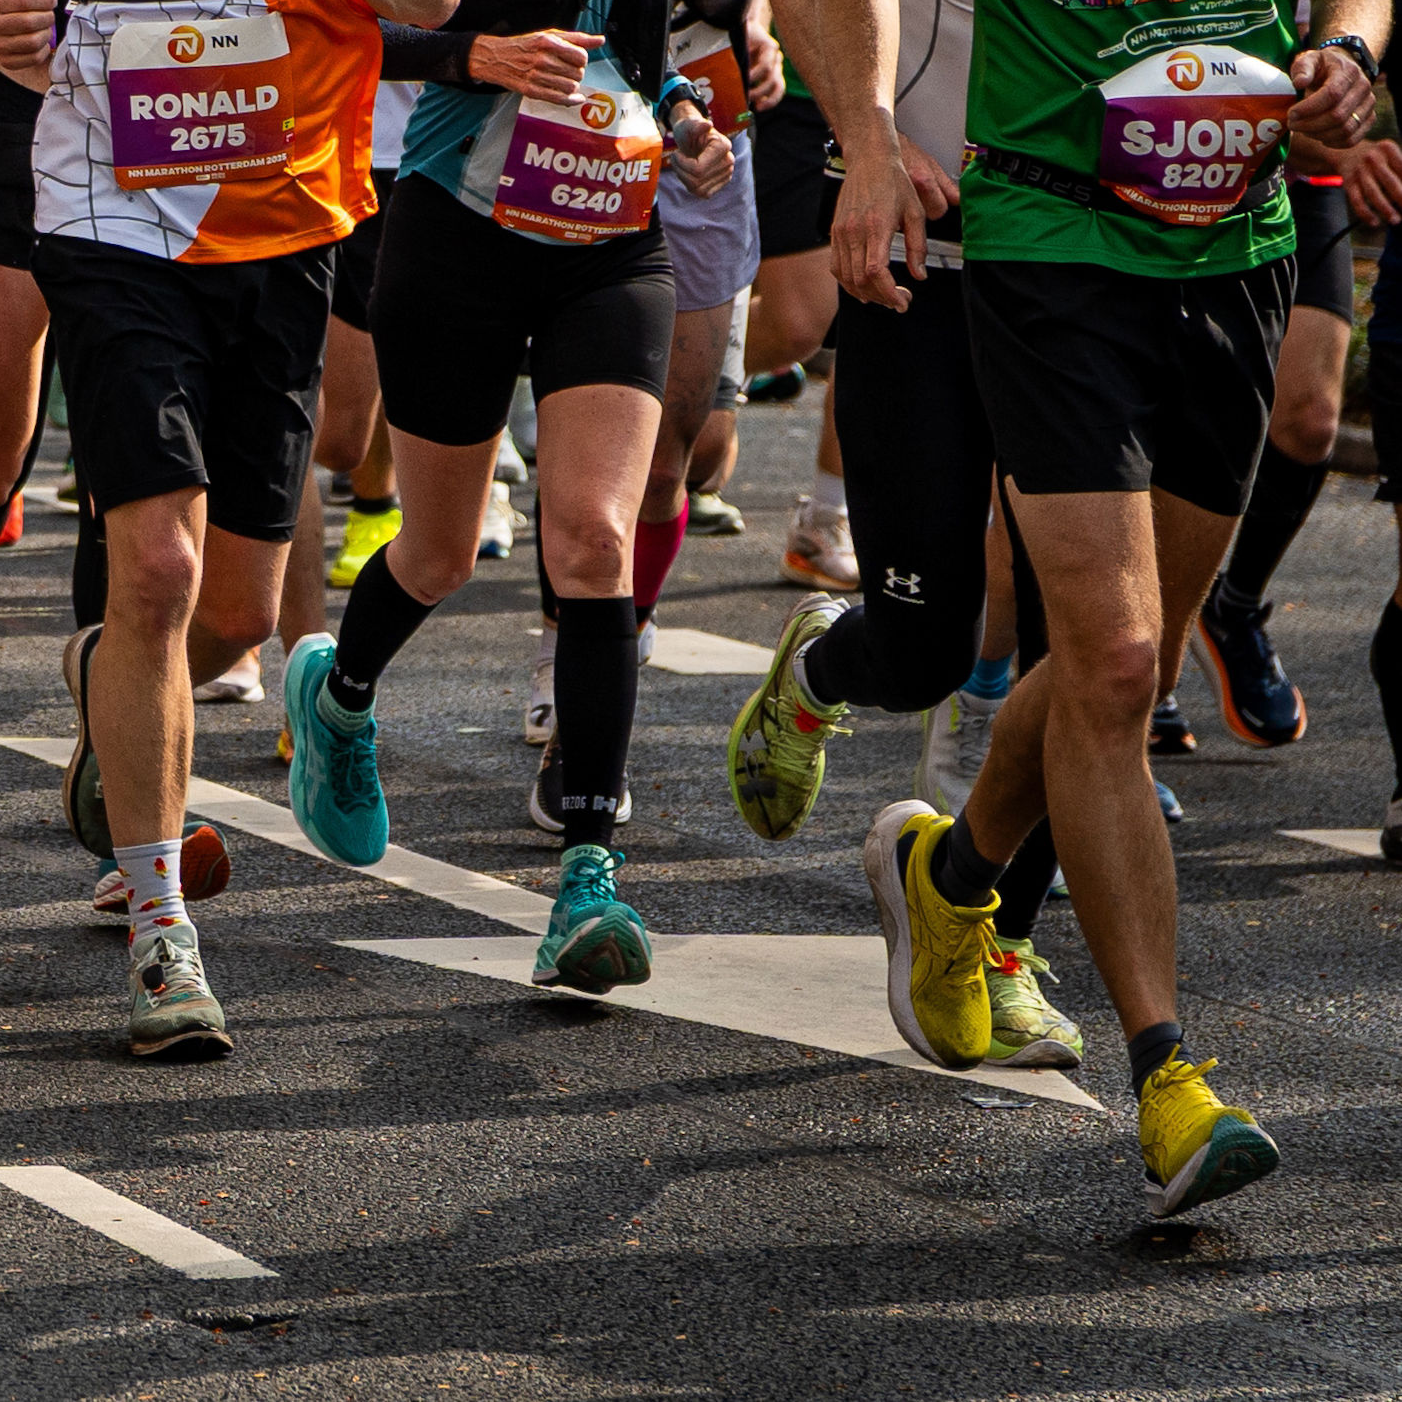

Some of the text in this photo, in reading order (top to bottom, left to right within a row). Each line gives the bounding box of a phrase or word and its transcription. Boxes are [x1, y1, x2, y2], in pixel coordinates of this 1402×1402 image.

[212, 34, 239, 48] NN
[1212, 62, 1237, 76] NN
[130, 85, 279, 120] RONALD
[170, 123, 246, 151] 2675
[1121, 118, 1283, 158] SJORS
[127, 169, 144, 178] NN
[145, 166, 203, 177] MARATHON
[204, 159, 265, 172] ROTTERDAM
[266, 153, 287, 165] 2025
[523, 142, 651, 188] MONIQUE
[1162, 163, 1244, 189] 8207
[551, 184, 623, 214] 6240
[1132, 189, 1188, 212] MARATHON
[505, 208, 519, 218] NN
[520, 212, 574, 230] MARATHON
